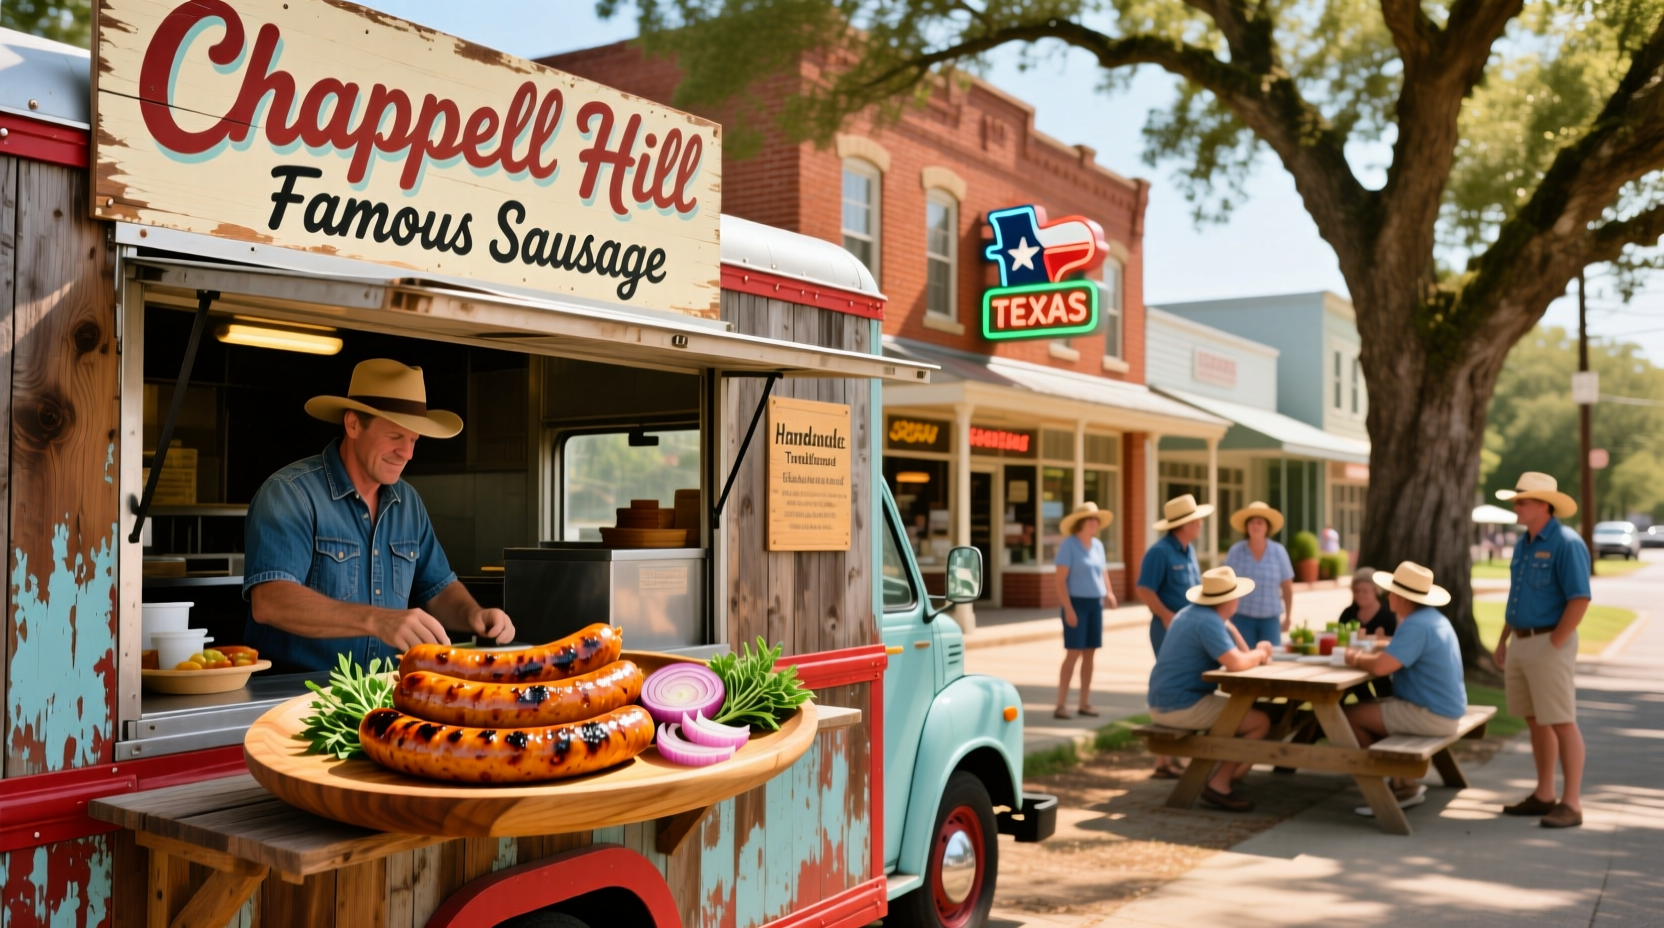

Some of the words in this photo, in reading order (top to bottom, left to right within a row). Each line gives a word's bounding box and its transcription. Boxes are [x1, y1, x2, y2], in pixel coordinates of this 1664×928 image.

[139, 0, 564, 191] Chappell
[576, 101, 704, 216] Hill
[267, 164, 474, 257] Famous
[489, 200, 668, 301] Sausage
[991, 291, 1087, 328] TEXAS
